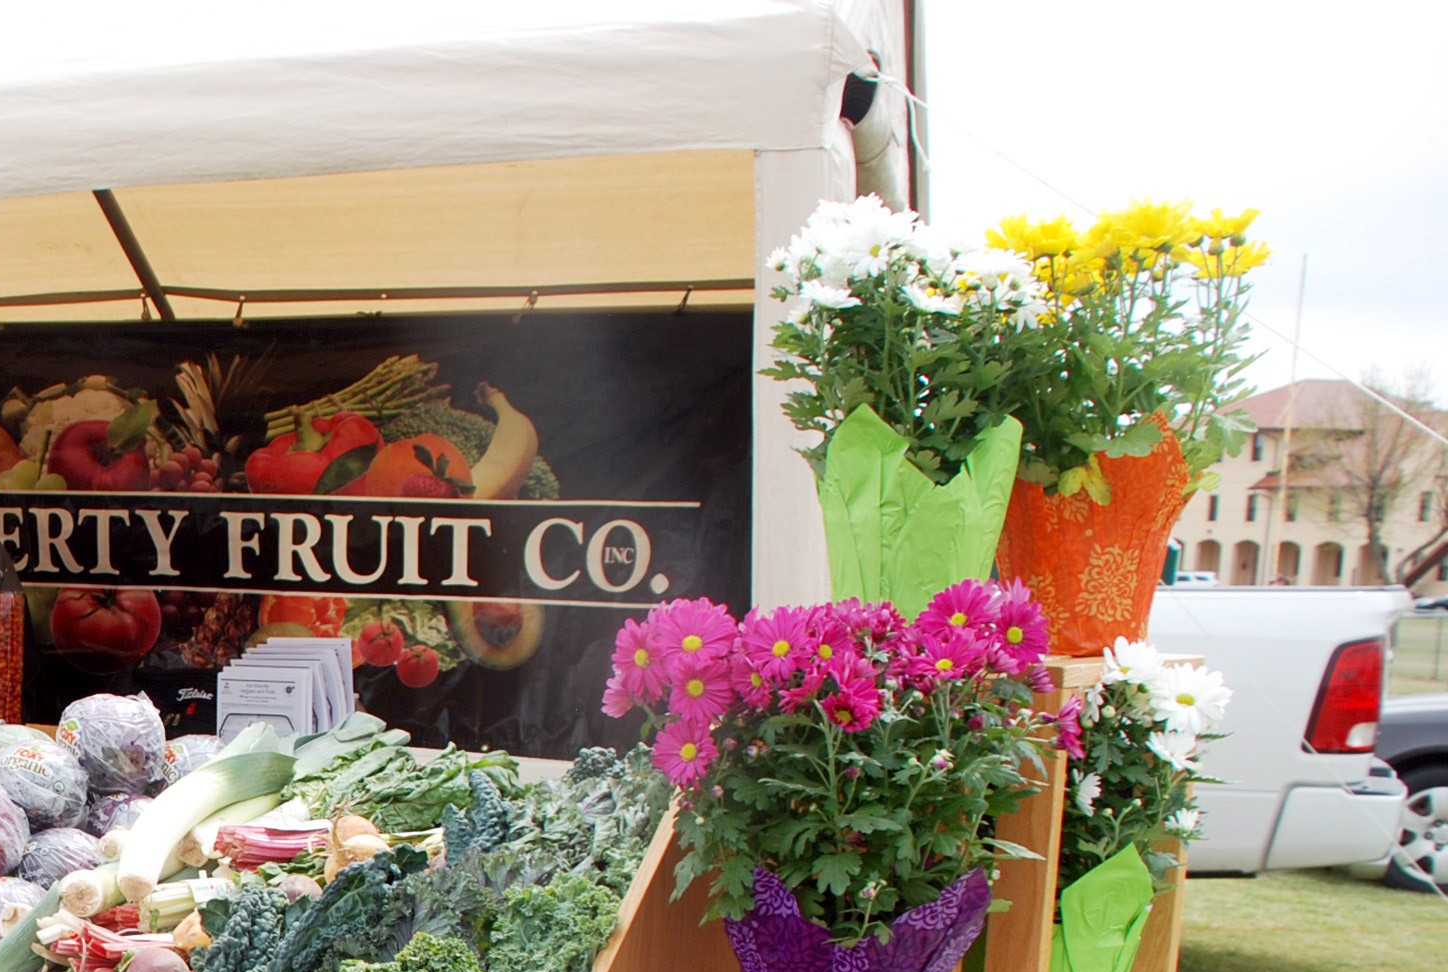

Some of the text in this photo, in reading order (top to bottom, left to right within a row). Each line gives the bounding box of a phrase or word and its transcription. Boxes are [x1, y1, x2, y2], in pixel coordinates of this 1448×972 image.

[223, 512, 492, 588] FRUIT
[524, 517, 670, 594] CO.
[604, 546, 635, 565] INC
[0, 757, 51, 777] organic
